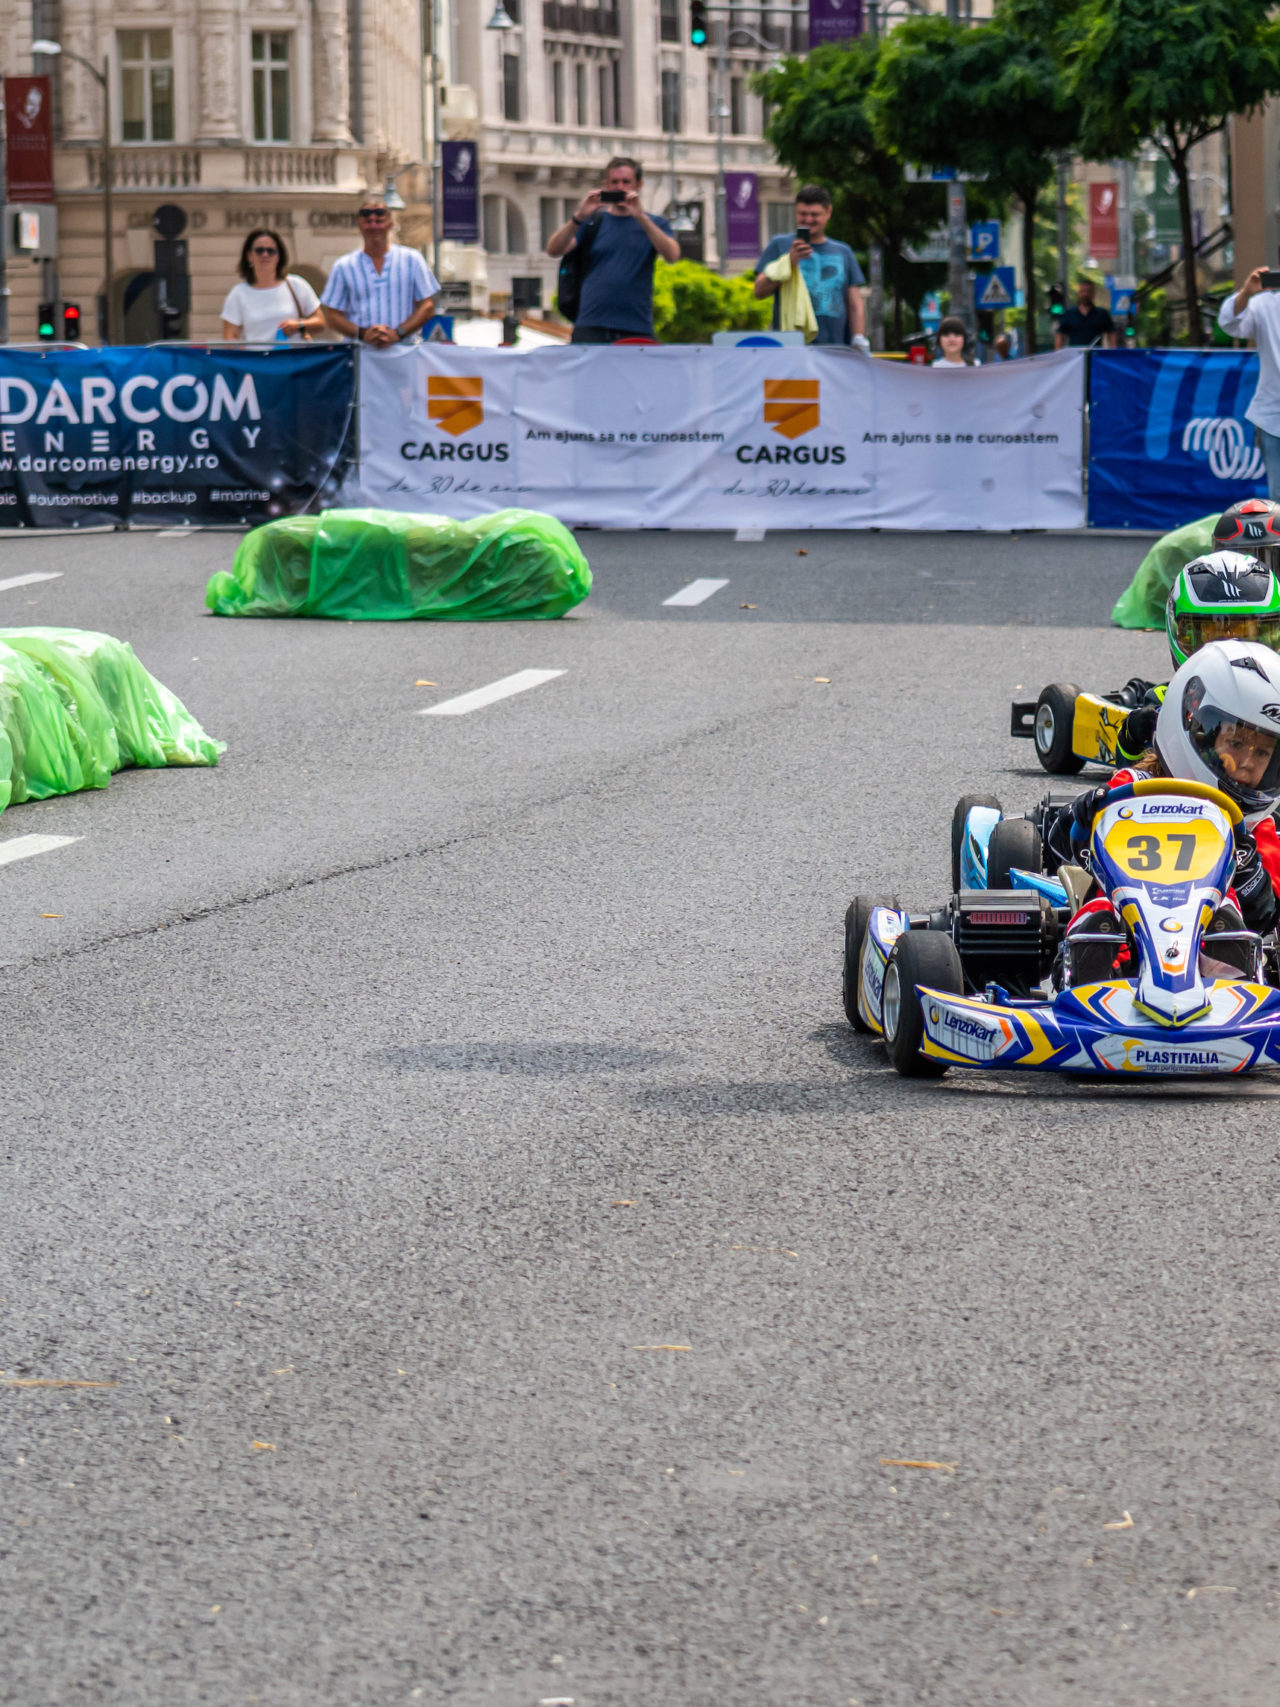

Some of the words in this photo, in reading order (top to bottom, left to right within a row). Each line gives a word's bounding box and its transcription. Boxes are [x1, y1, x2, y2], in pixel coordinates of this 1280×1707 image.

[225, 210, 297, 229] HOTEL
[0, 373, 262, 424] DARCOM
[525, 429, 550, 442] Am
[554, 429, 596, 445] ajuns
[599, 431, 616, 443] sa
[619, 431, 637, 443] ne
[641, 430, 725, 443] cunoastem
[862, 432, 888, 444] Am
[891, 432, 931, 447] ajuns
[935, 433, 952, 444] sa
[955, 433, 974, 444] ne
[977, 432, 1059, 445] cunoastem
[400, 441, 510, 463] CARGUS
[735, 445, 847, 465] CARGUS
[423, 475, 455, 495] 30
[756, 478, 791, 498] 30
[27, 491, 119, 507] #automotive
[132, 489, 197, 506] #backup
[210, 487, 271, 504] #marine
[1141, 803, 1205, 816] Lenzokart
[1126, 833, 1197, 872] 37
[943, 1010, 998, 1044] Lenzokart
[1136, 1050, 1219, 1064] PLASTITALIA
